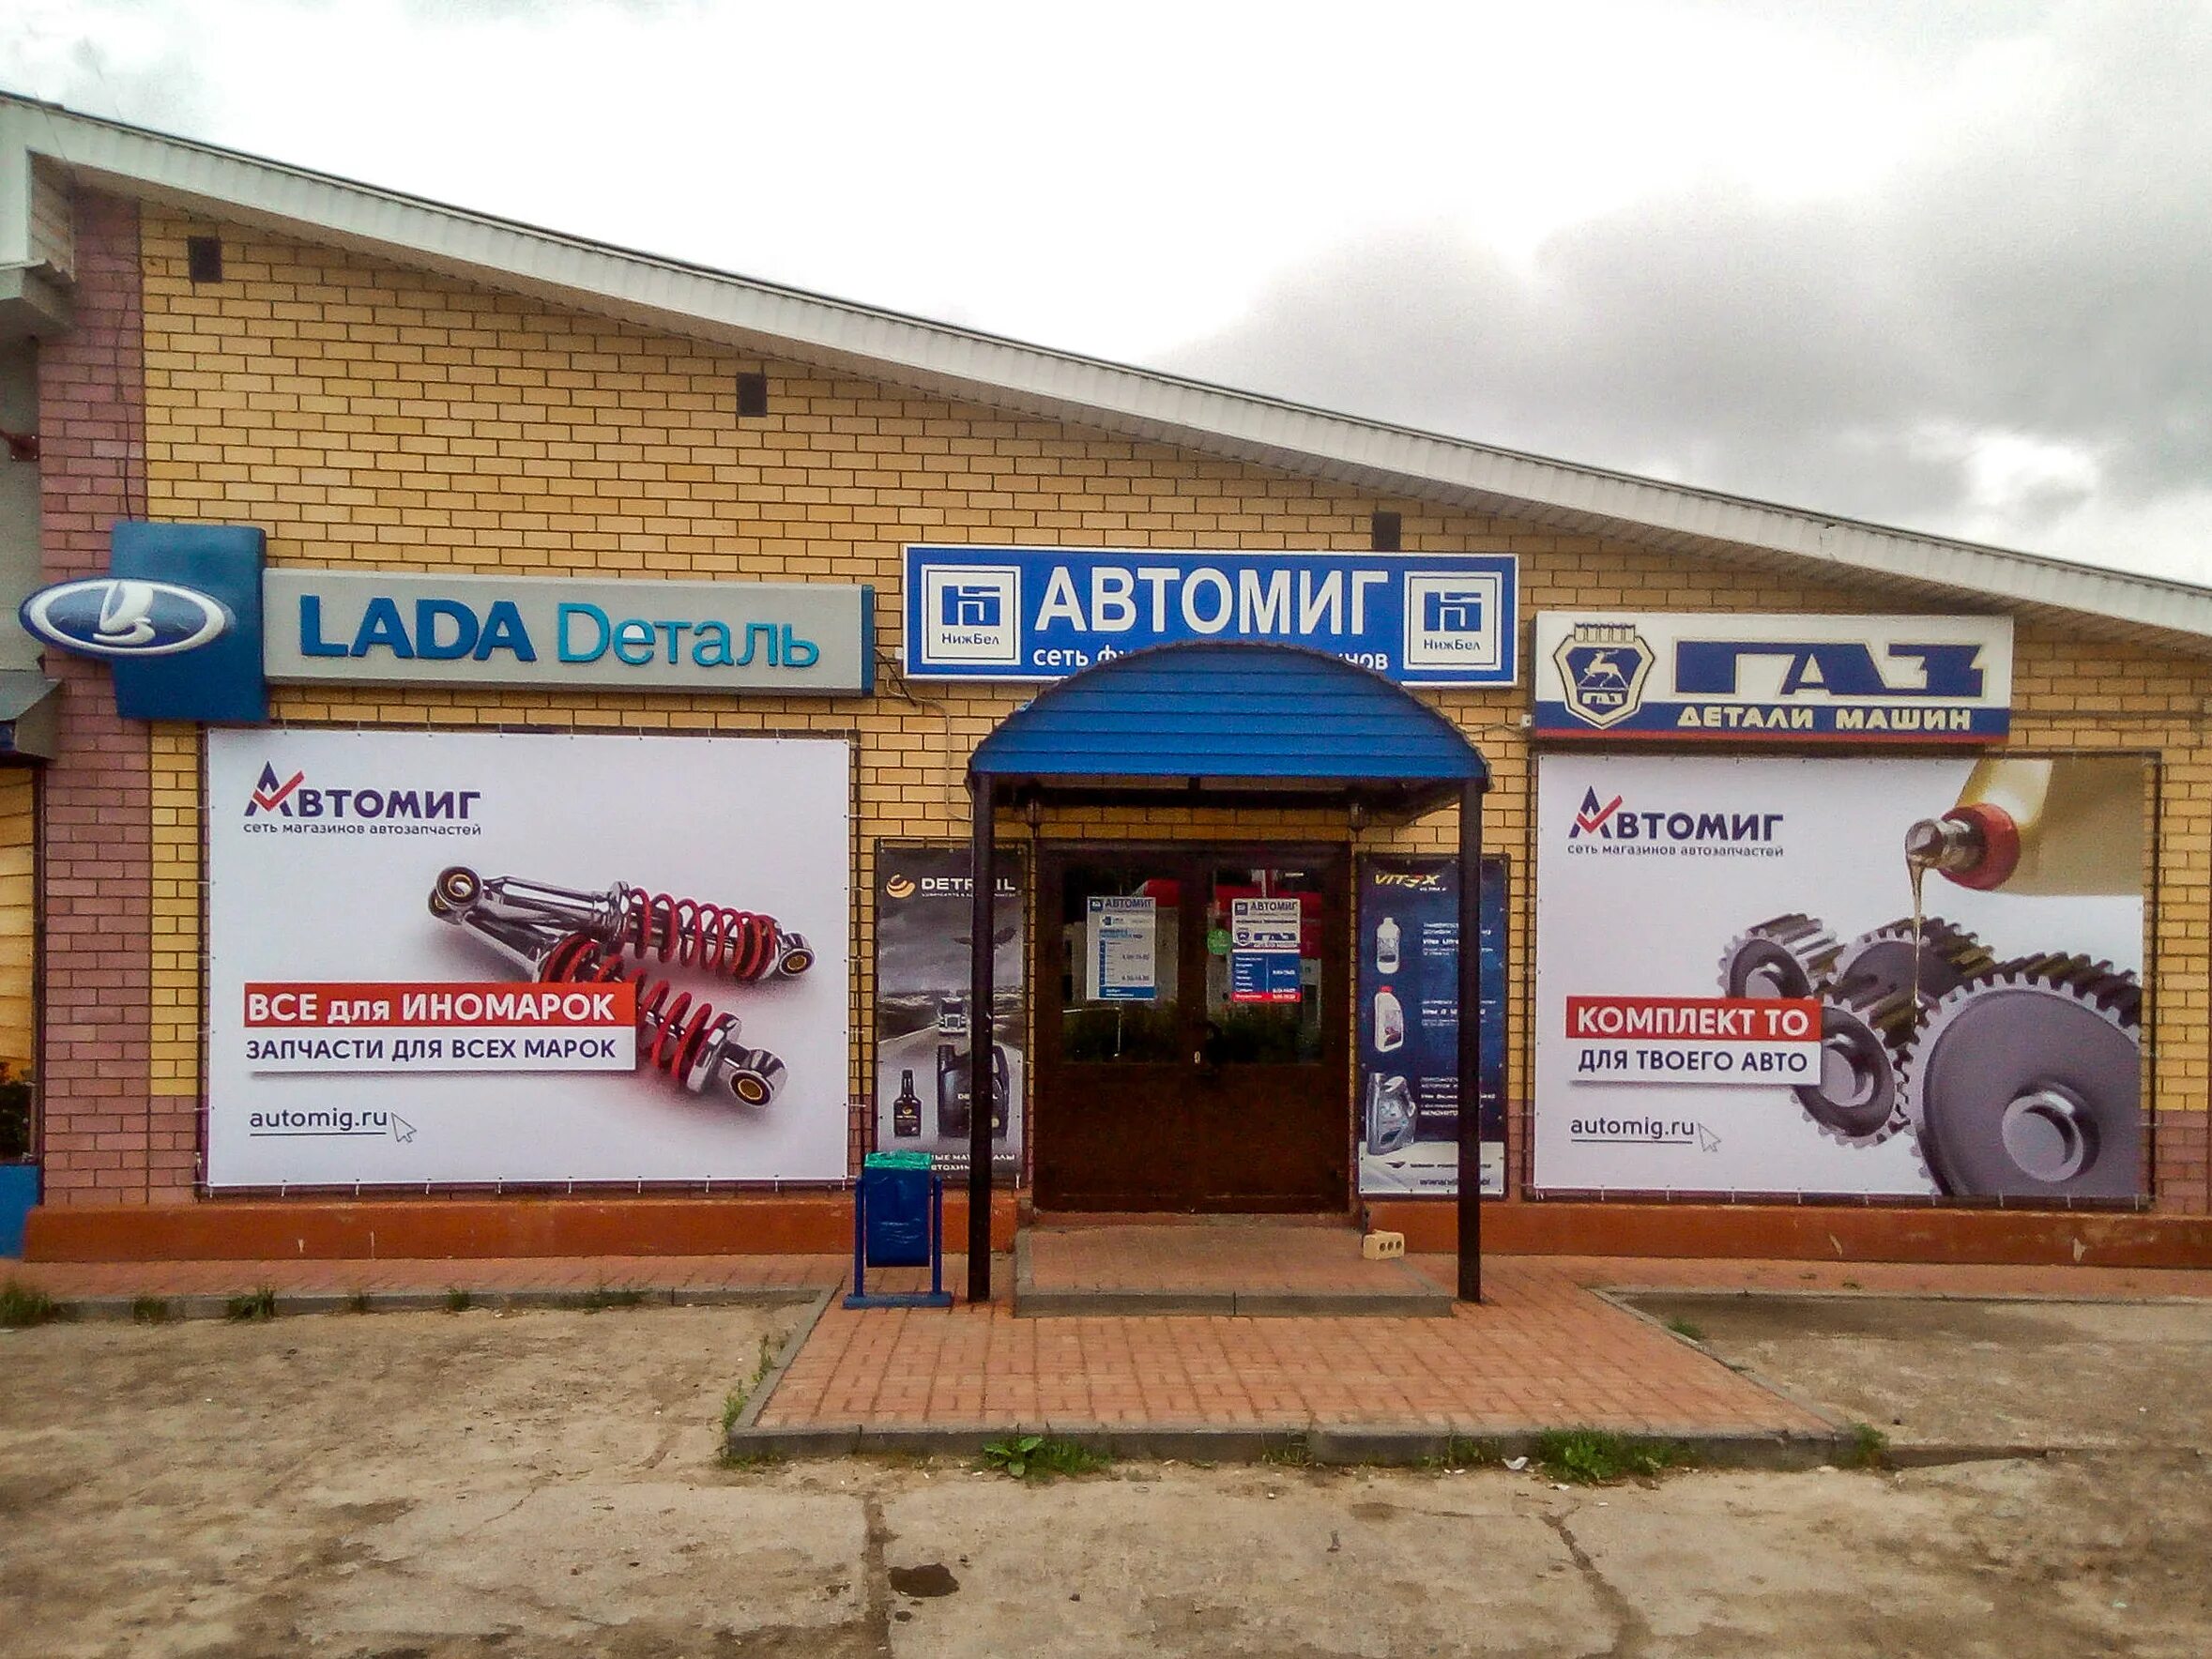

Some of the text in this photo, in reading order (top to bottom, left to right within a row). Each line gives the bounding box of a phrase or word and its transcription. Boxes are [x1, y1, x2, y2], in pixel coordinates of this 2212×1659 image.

[1033, 566, 1389, 636] АВТОМИГ
[299, 594, 537, 662] LADA
[941, 632, 1000, 646] НижБел
[1423, 638, 1481, 652] НижБел
[1032, 647, 1090, 668] сеть
[1675, 640, 1983, 698] ГАЗ
[1676, 706, 1971, 731] ДЕТАЛИ МАШИН
[242, 823, 482, 836] сеть магазинов автозапчастей
[1567, 845, 1784, 857] сеть магазинов автозапчастей
[921, 877, 1016, 891] DETRIL
[247, 993, 616, 1025] ВСЕ для ИНОМАРОК
[1577, 1006, 1809, 1036] КОМПЛЕКТ ТО
[246, 1039, 617, 1062] ЗАПЧАСТИ ДЛЯ ВСЕХ МАРОК
[1578, 1049, 1808, 1073] ДЛЯ ТВОЕГО АВТО
[249, 1107, 388, 1132] automig.ru
[1570, 1116, 1695, 1139] automig.ru
